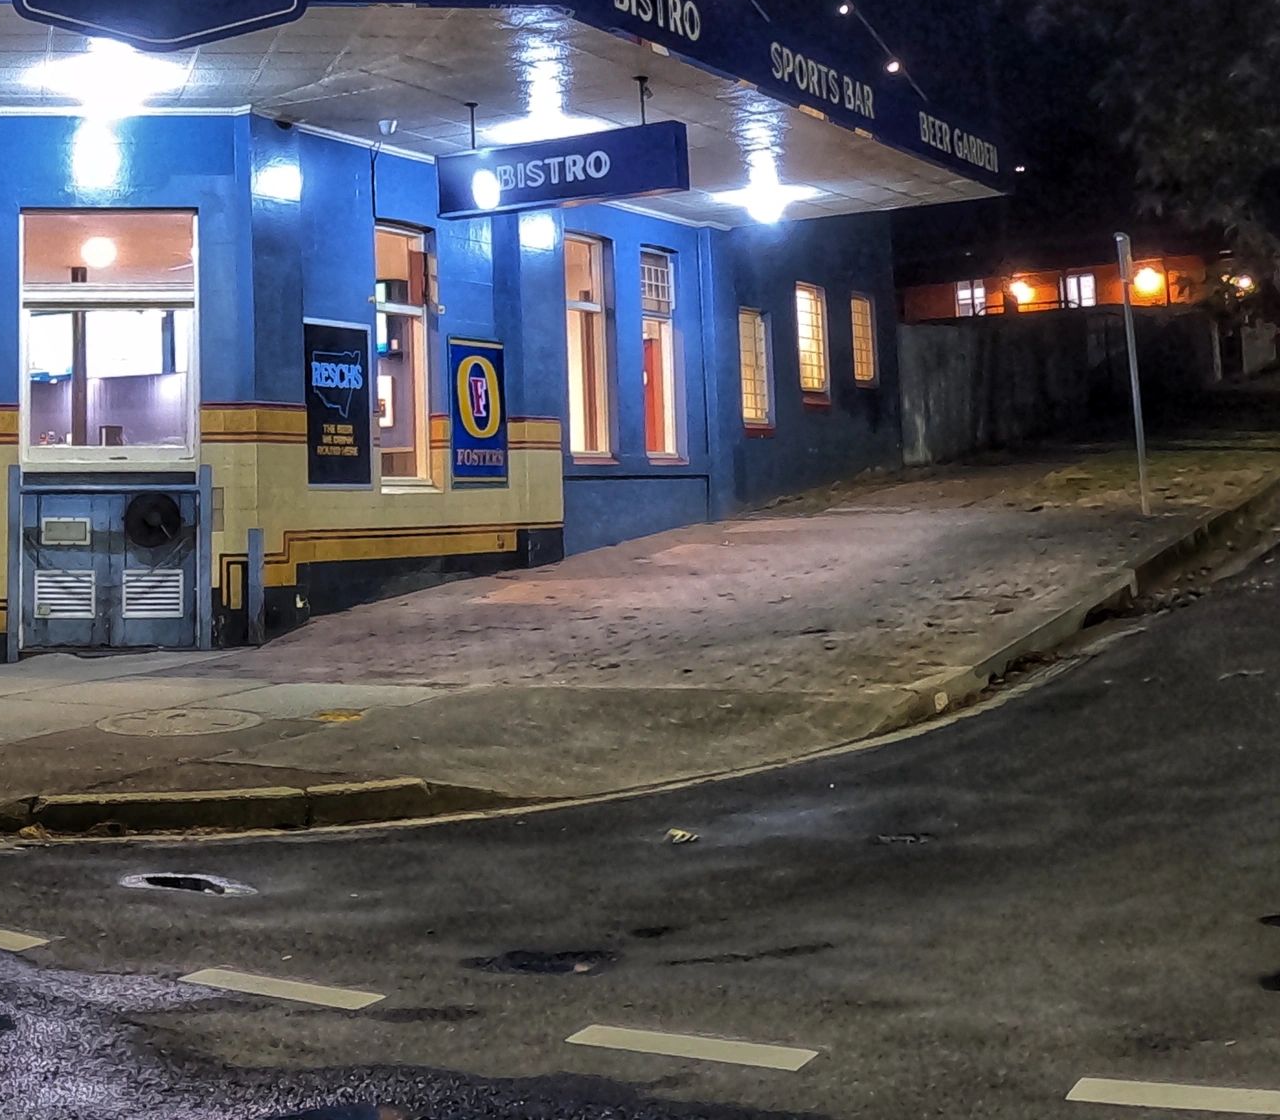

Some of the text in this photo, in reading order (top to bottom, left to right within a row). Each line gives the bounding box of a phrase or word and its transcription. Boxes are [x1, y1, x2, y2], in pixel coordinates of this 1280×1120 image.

[770, 41, 875, 119] SPORTS BAR
[919, 111, 998, 173] BEER GARDEN
[496, 150, 610, 191] BISTRO
[311, 362, 363, 389] RESCHS
